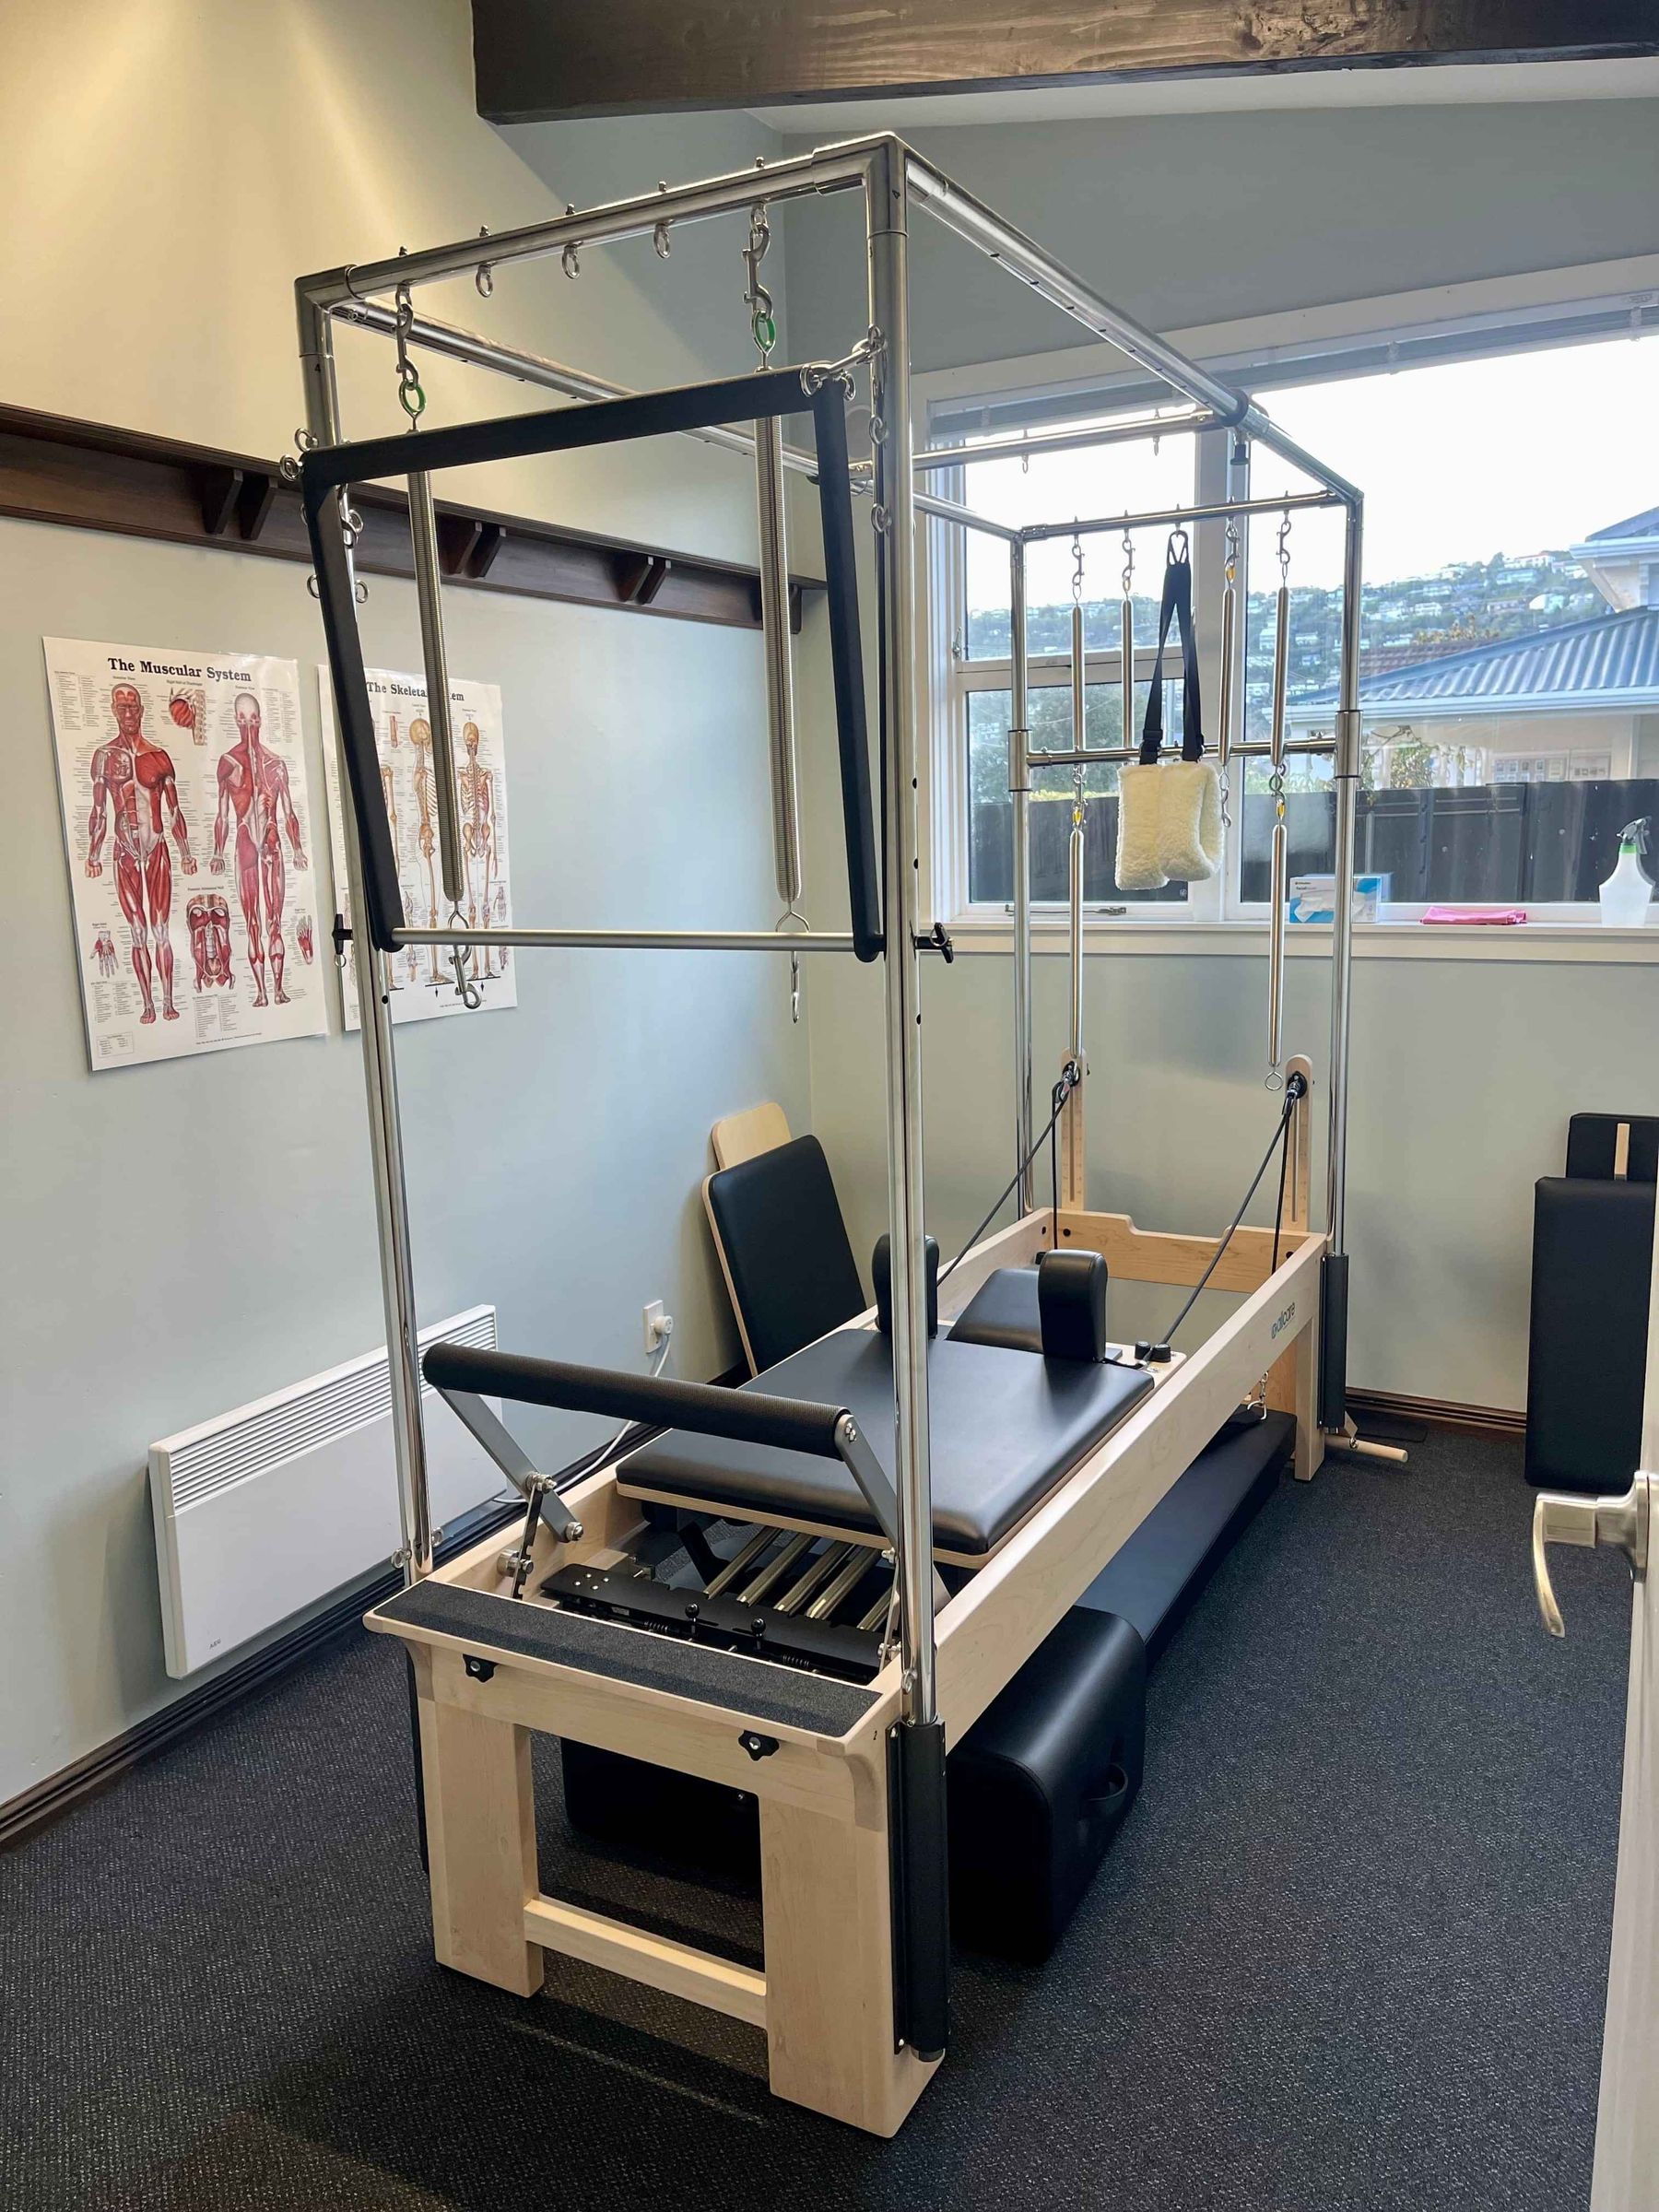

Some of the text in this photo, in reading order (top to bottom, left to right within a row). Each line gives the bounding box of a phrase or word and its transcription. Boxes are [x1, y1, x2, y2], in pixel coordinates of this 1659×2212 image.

[107, 657, 252, 682] The Muscular System
[366, 681, 428, 698] The Skeleta
